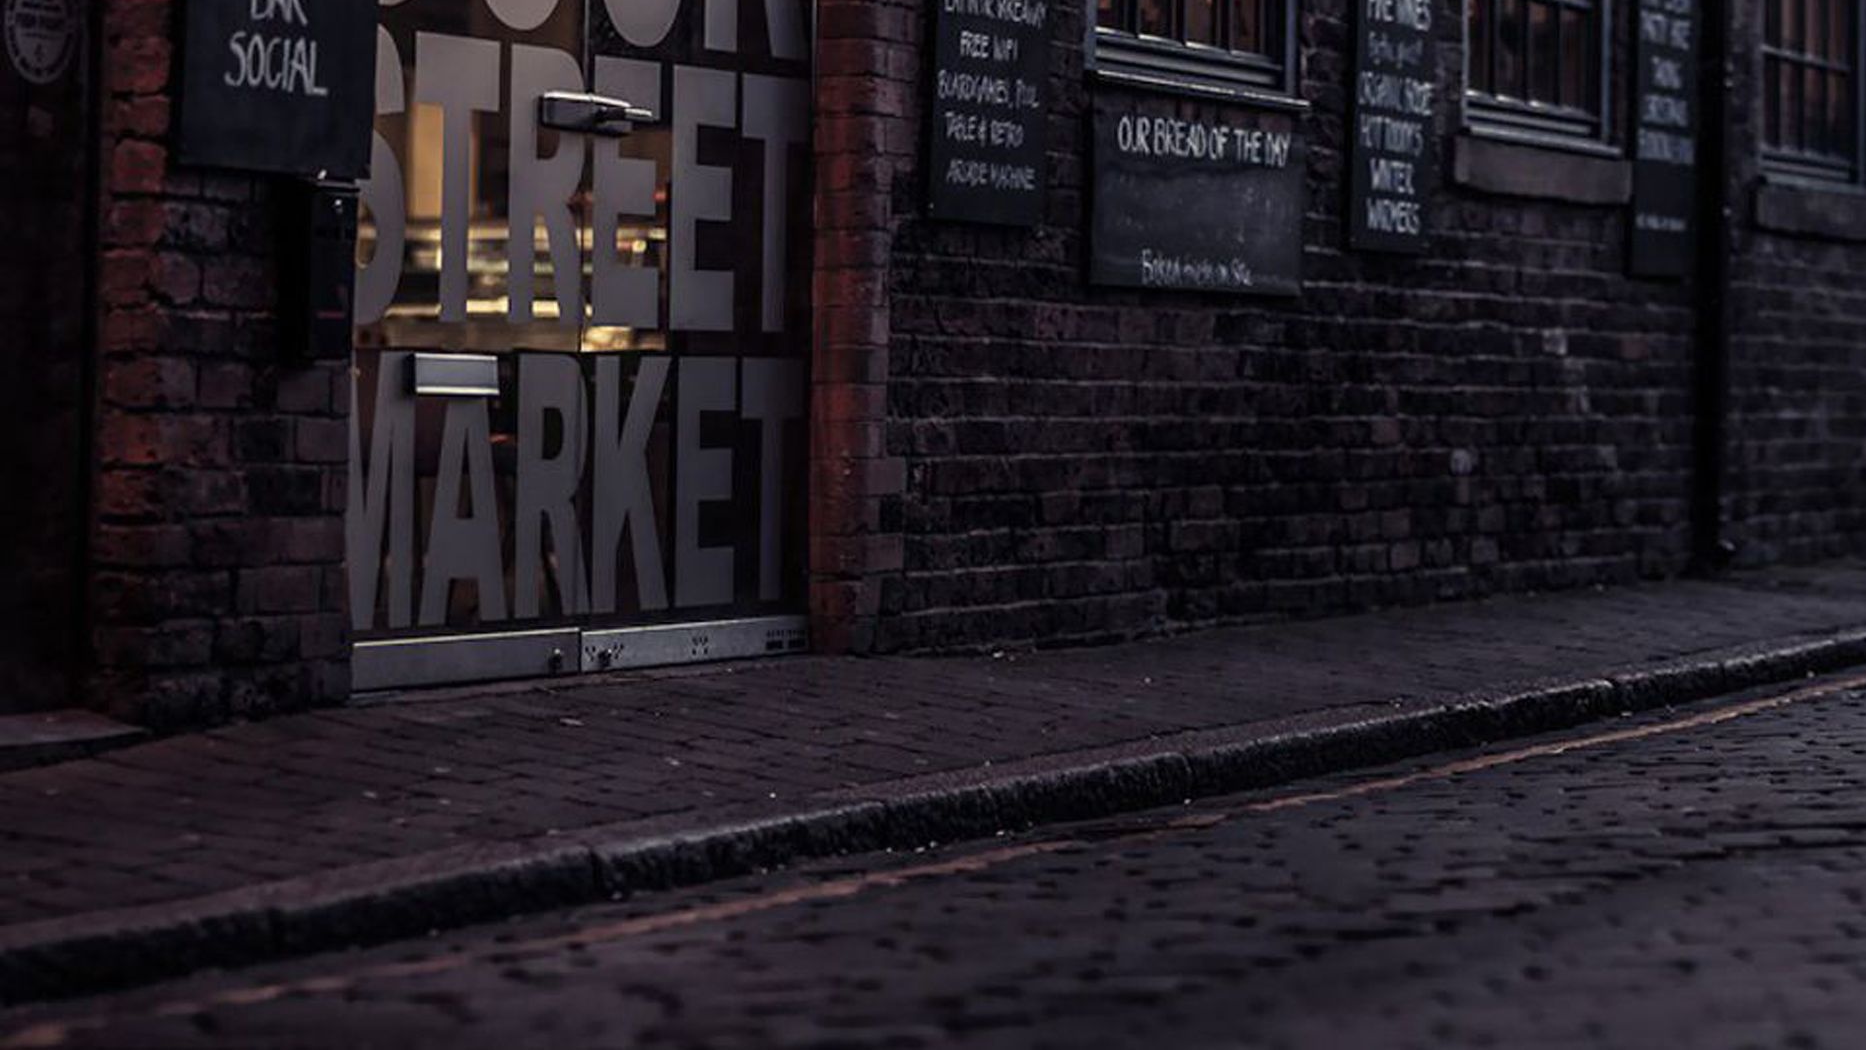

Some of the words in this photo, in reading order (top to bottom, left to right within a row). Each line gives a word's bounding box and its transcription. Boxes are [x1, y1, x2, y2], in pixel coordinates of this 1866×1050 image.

[223, 29, 329, 97] SOCIAL
[959, 30, 990, 59] FREE
[1117, 114, 1150, 156] OUR
[1153, 116, 1207, 158] BREAD
[1208, 125, 1230, 161] OF
[1233, 128, 1263, 164] THE
[1264, 131, 1292, 169] DAY
[346, 349, 808, 630] MARKET
